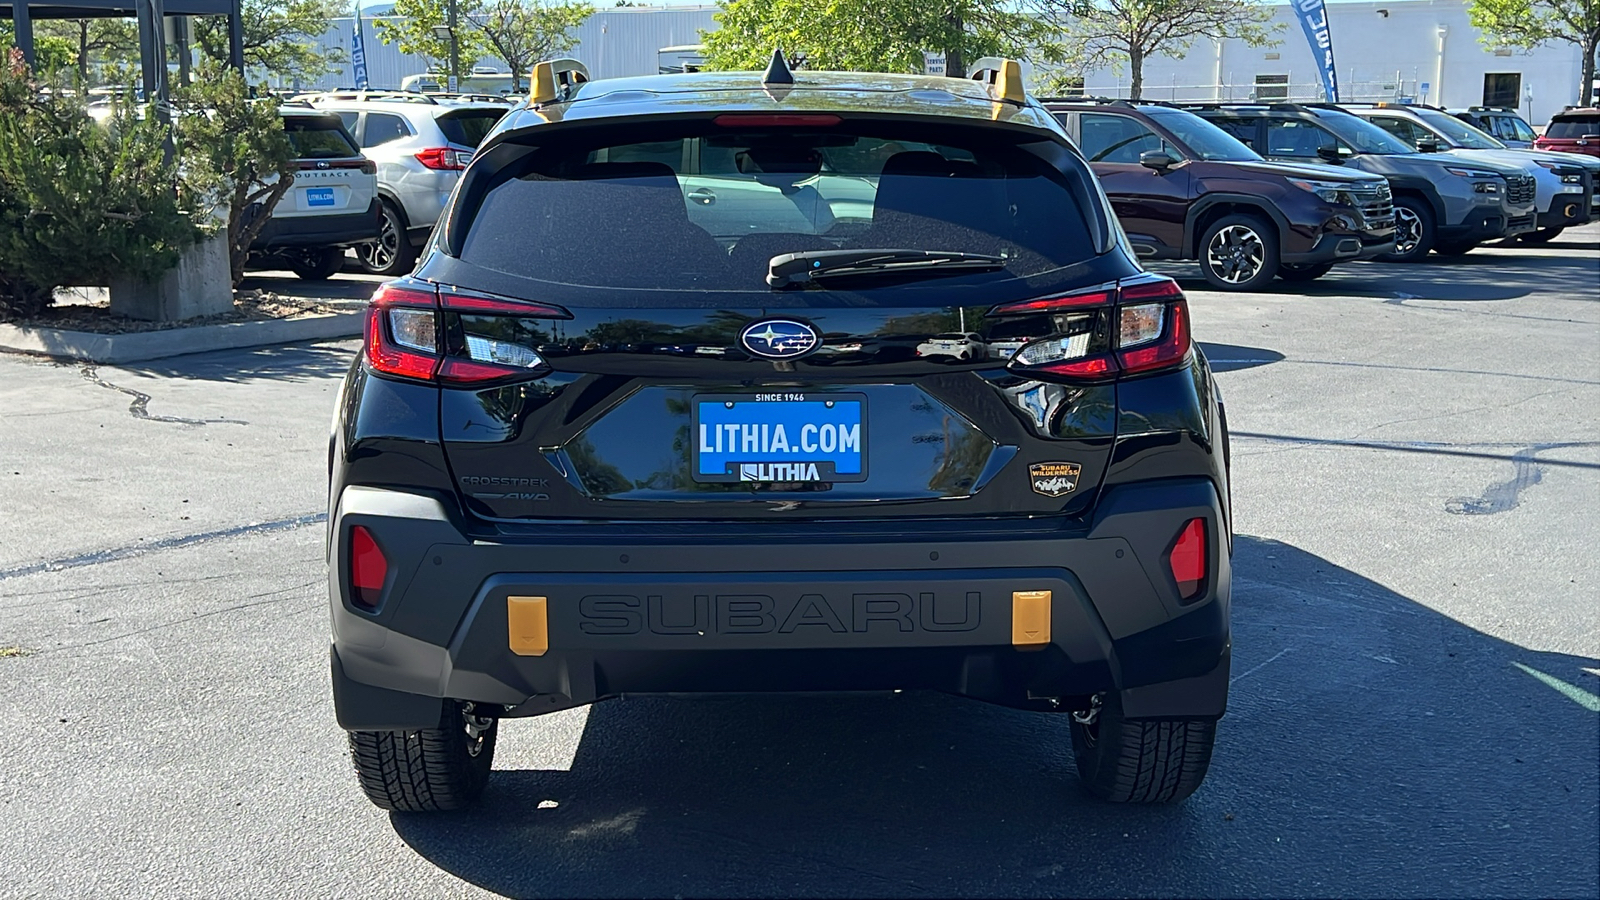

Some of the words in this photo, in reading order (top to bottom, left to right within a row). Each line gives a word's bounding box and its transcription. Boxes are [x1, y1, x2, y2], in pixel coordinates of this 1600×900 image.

[755, 394, 782, 402] SINCE
[784, 394, 804, 402] 1946
[700, 423, 860, 453] LITHIA.COM
[758, 463, 820, 481] LITHIA
[461, 476, 550, 487] CROSSTREK
[503, 492, 550, 501] AWD
[579, 592, 981, 635] SUBARU
